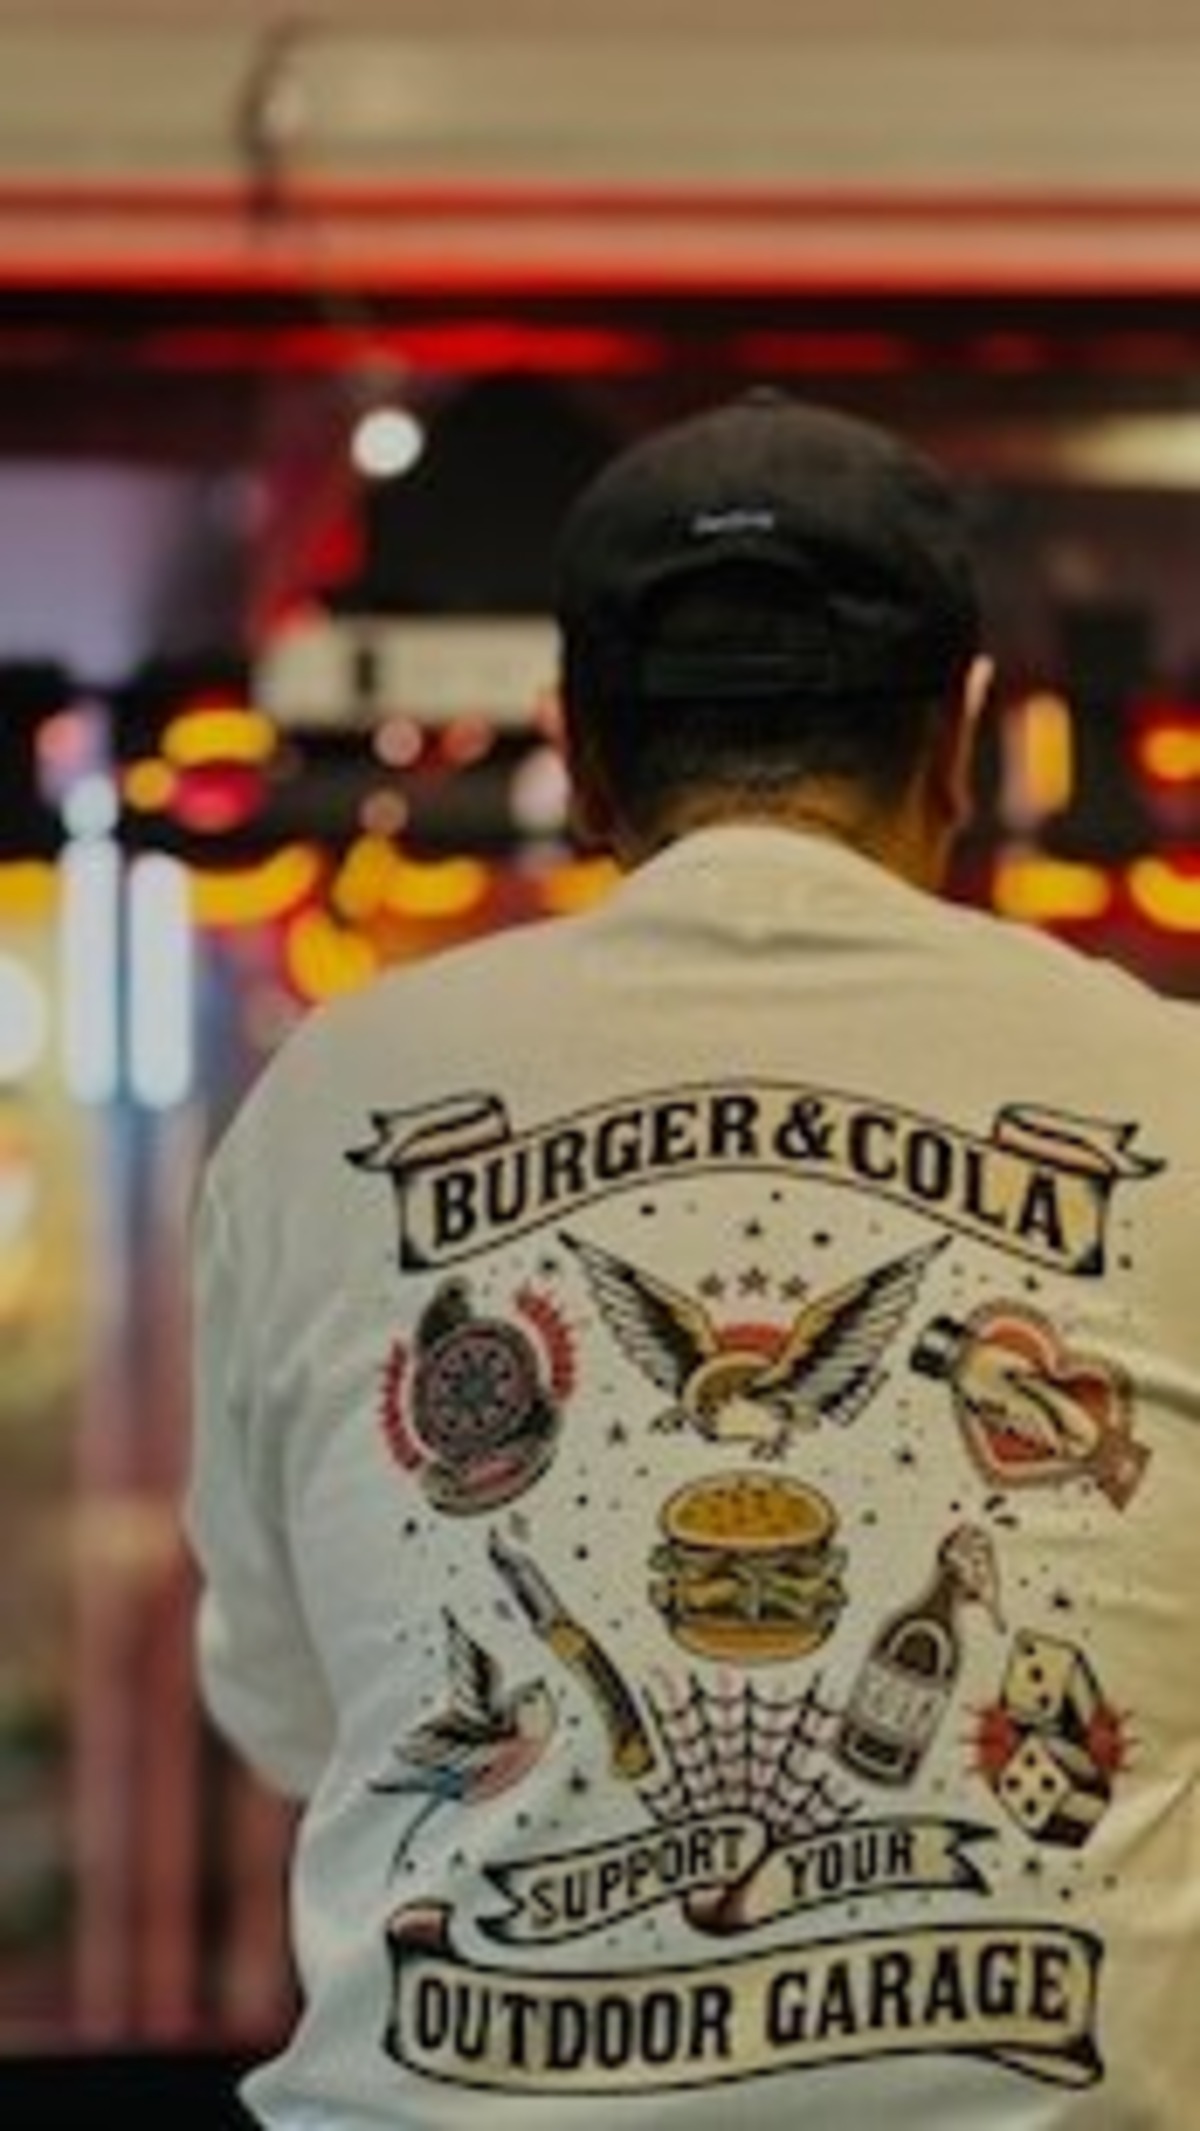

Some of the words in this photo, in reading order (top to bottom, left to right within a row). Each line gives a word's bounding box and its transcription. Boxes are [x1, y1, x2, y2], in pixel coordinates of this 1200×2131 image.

[528, 1825, 748, 1930] SUPPORT
[784, 1829, 917, 1898] YOUR
[415, 1976, 734, 2071] OUTDOOR
[765, 1942, 1072, 2048] GARAGE
